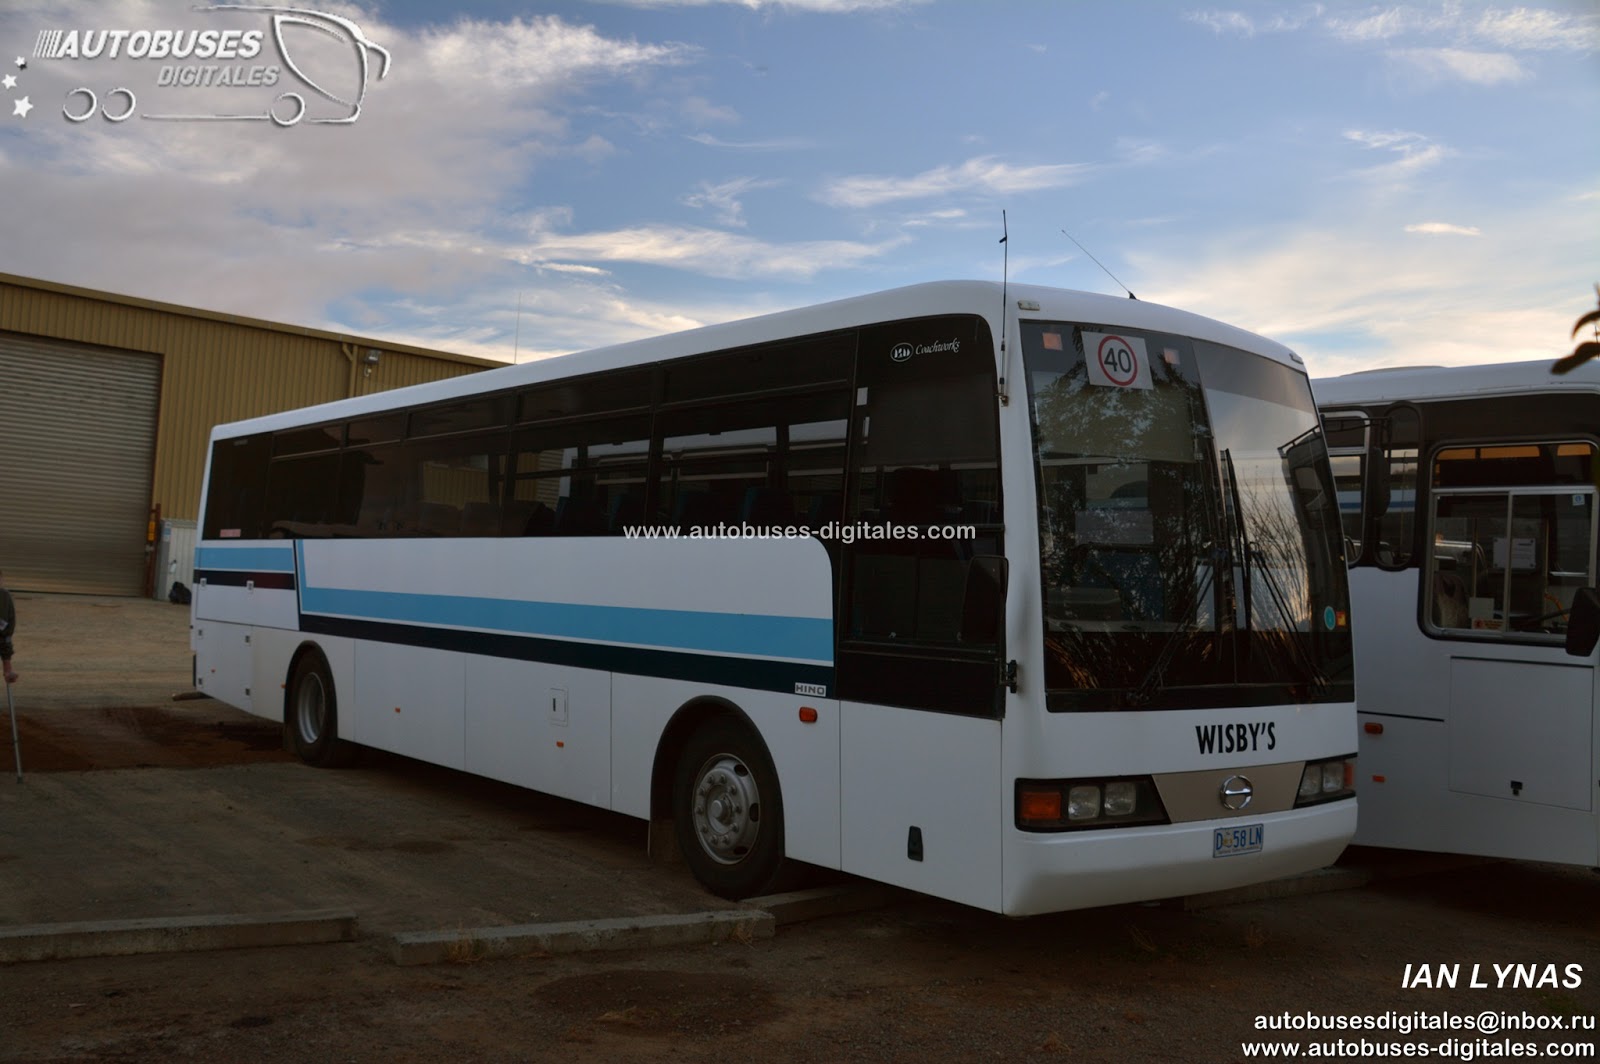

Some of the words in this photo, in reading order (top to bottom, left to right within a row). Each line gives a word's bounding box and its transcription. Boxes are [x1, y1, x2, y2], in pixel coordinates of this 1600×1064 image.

[915, 337, 961, 355] Coachworks
[1103, 347, 1132, 373] 40
[796, 684, 825, 696] HINO
[1195, 721, 1276, 755] WISBY'S
